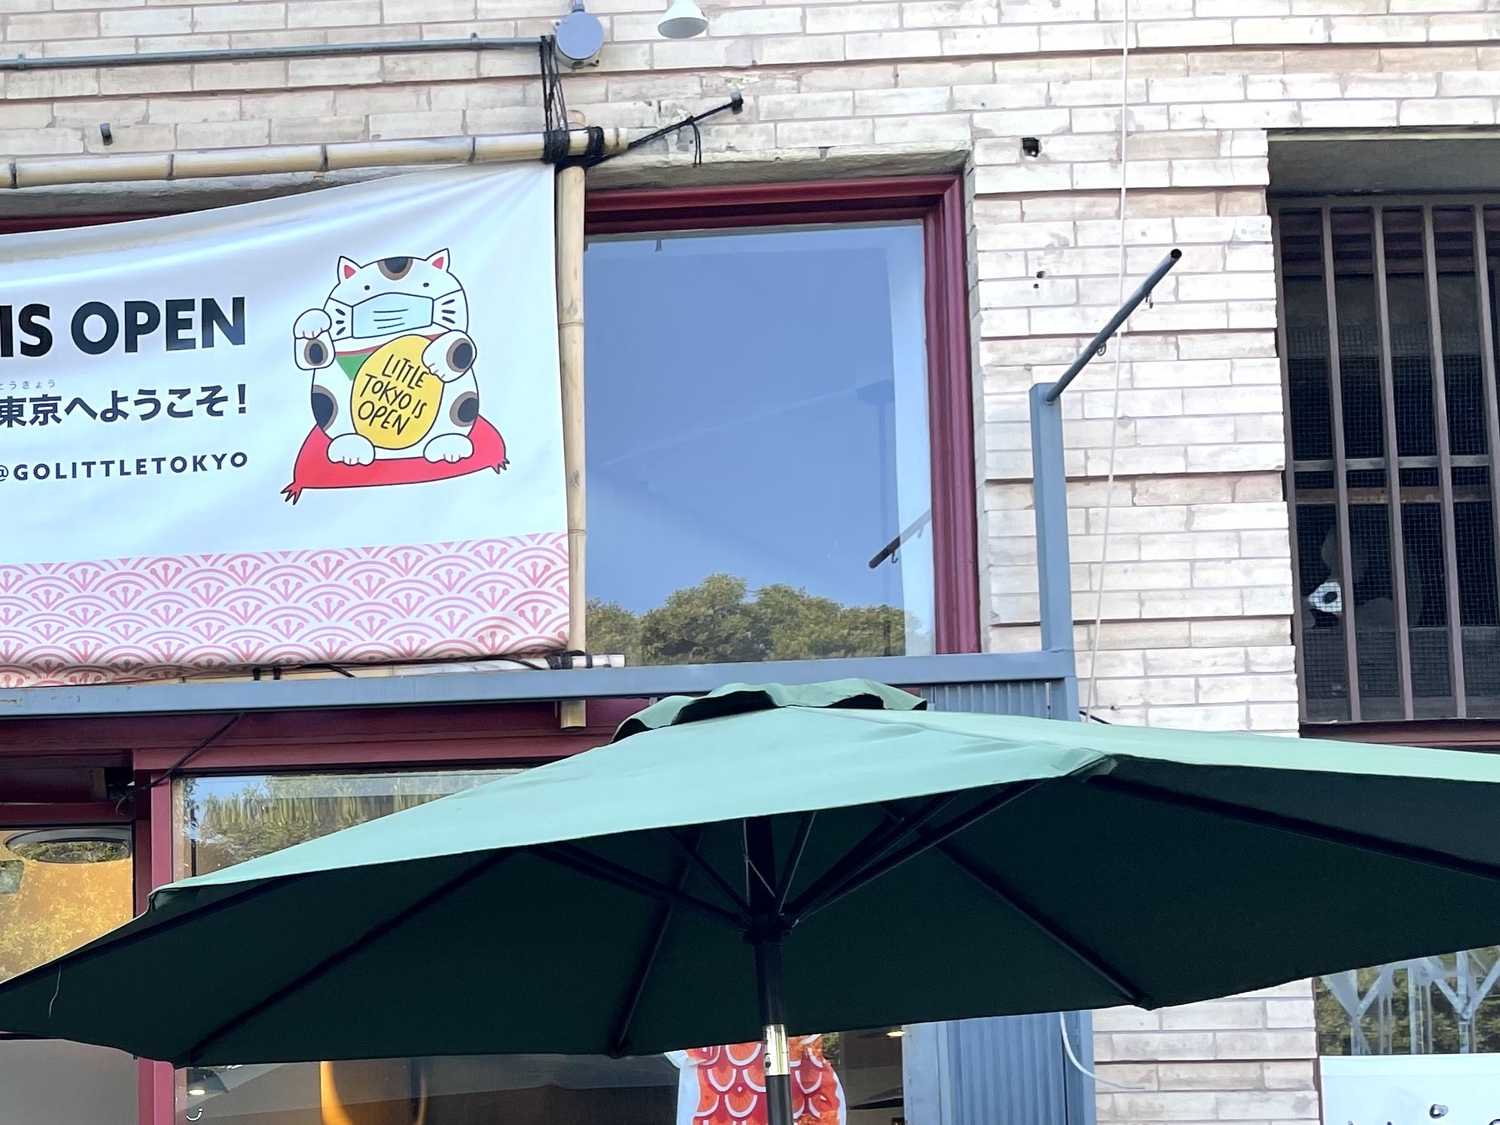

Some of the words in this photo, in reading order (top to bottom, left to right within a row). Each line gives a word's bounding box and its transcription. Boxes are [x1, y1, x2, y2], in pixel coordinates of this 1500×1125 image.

[0, 303, 53, 358] IS
[71, 297, 246, 355] OPEN
[381, 353, 430, 390] LITTLE
[360, 373, 412, 410] TOKYO
[411, 399, 428, 419] IS
[358, 400, 411, 435] OPEN
